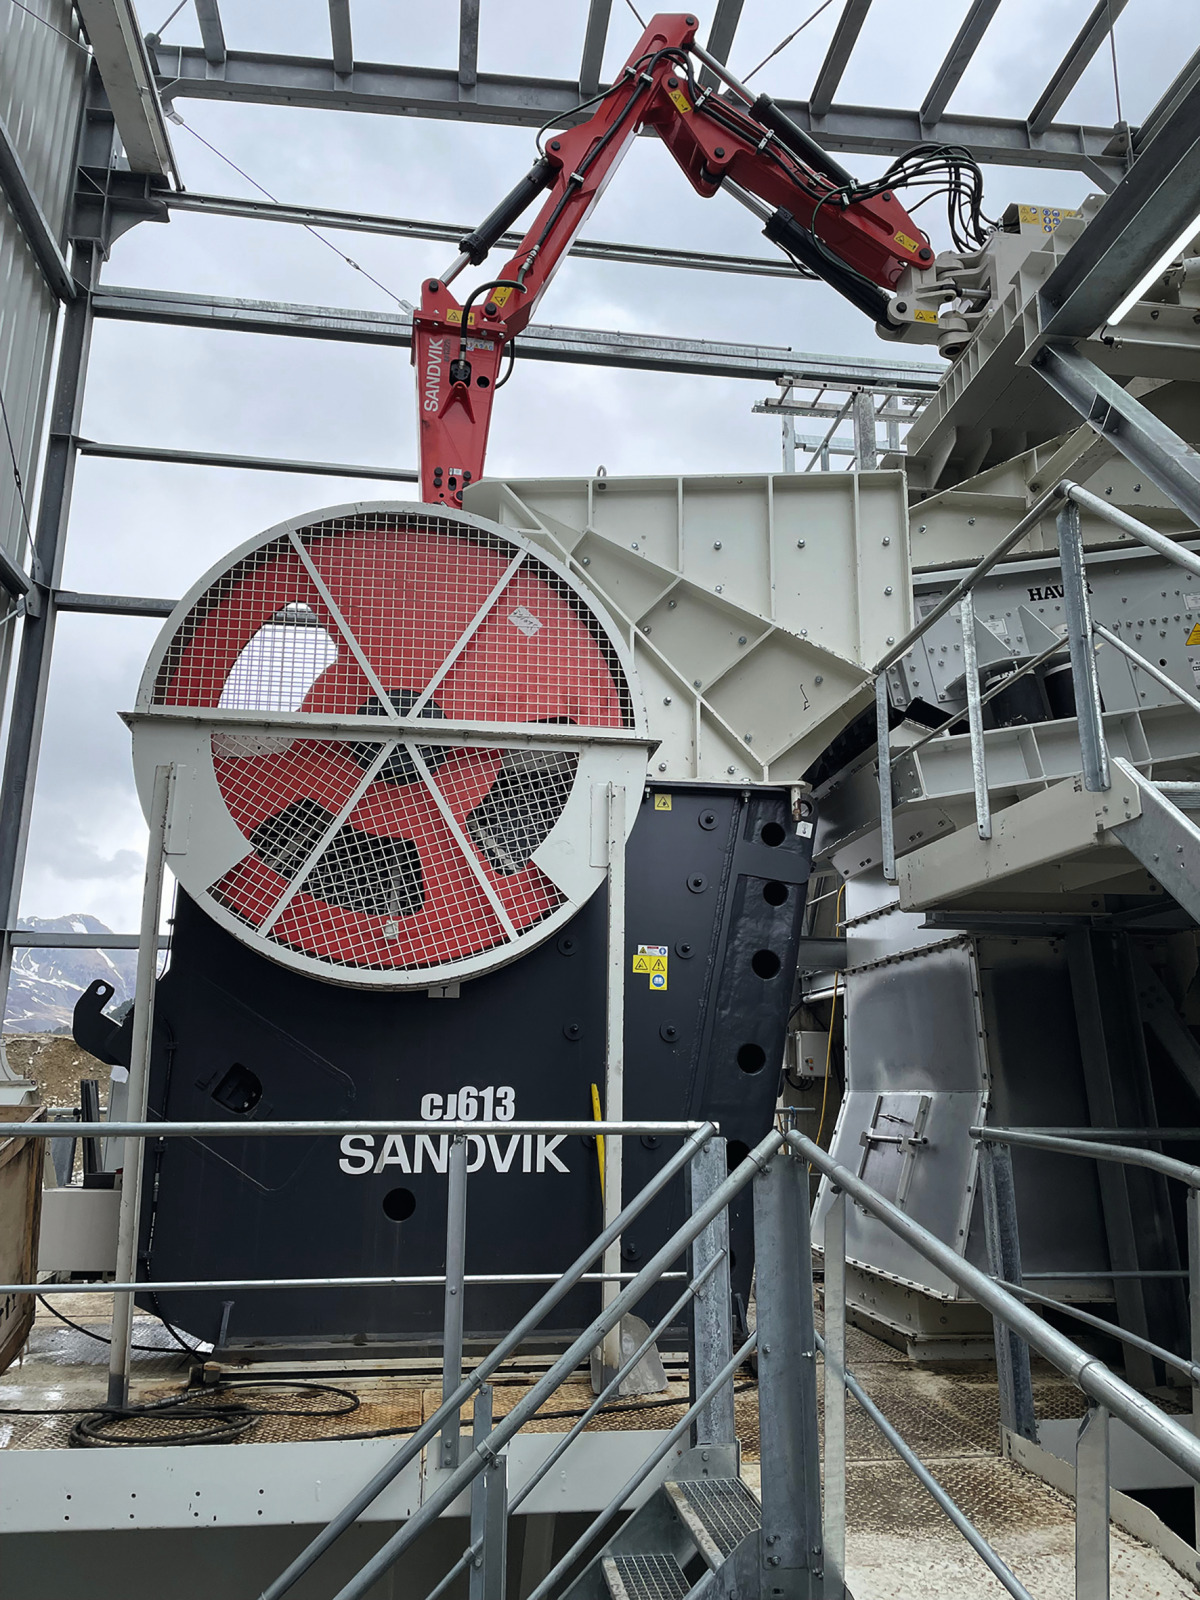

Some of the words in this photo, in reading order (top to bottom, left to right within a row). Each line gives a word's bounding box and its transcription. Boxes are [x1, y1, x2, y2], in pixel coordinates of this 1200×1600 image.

[424, 338, 443, 411] SANDVIK
[1027, 582, 1093, 601] HAV
[338, 1134, 571, 1175] SANDVIK
